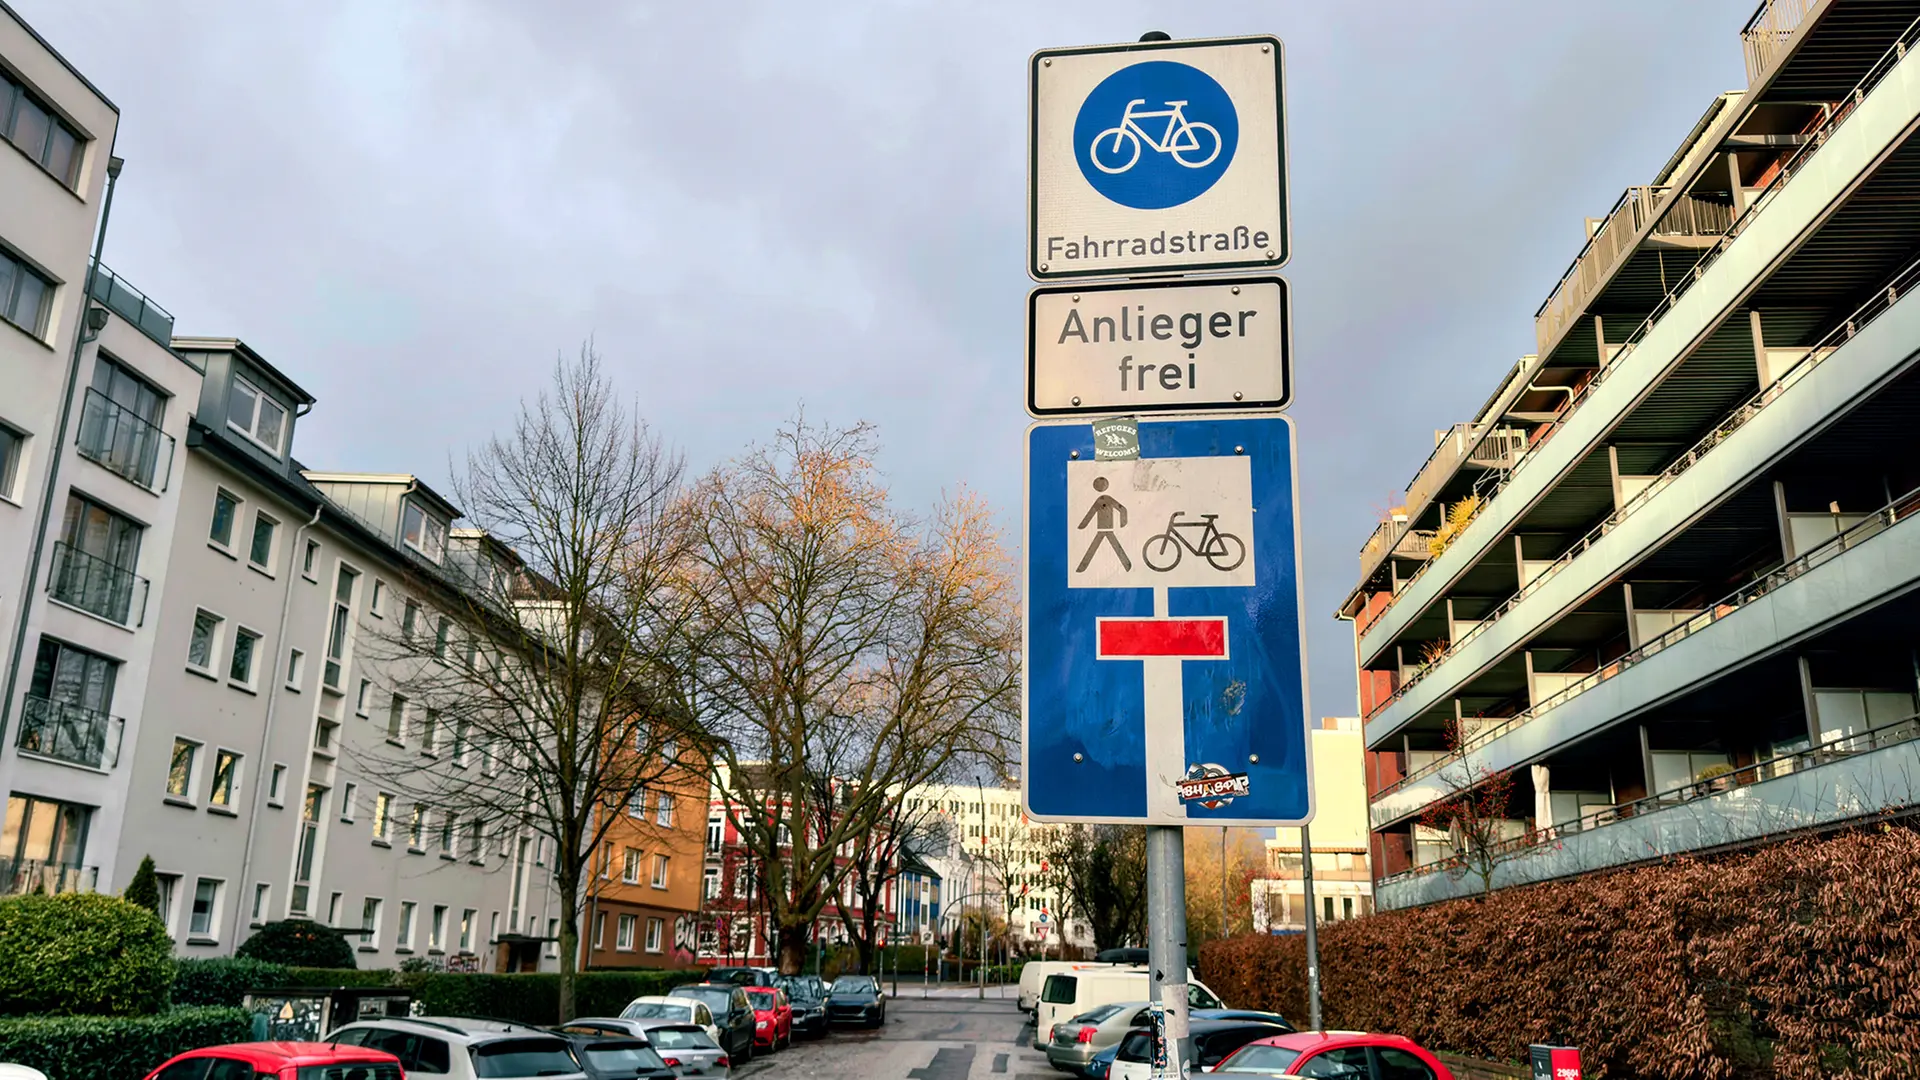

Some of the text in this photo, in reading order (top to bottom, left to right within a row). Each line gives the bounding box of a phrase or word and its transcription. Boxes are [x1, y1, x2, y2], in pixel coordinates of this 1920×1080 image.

[1048, 225, 1269, 261] Fahrradstraße
[1058, 305, 1257, 349] Anlieger
[1118, 353, 1195, 391] frei
[1095, 425, 1137, 437] REFUGEES
[1095, 446, 1137, 457] WELCOME
